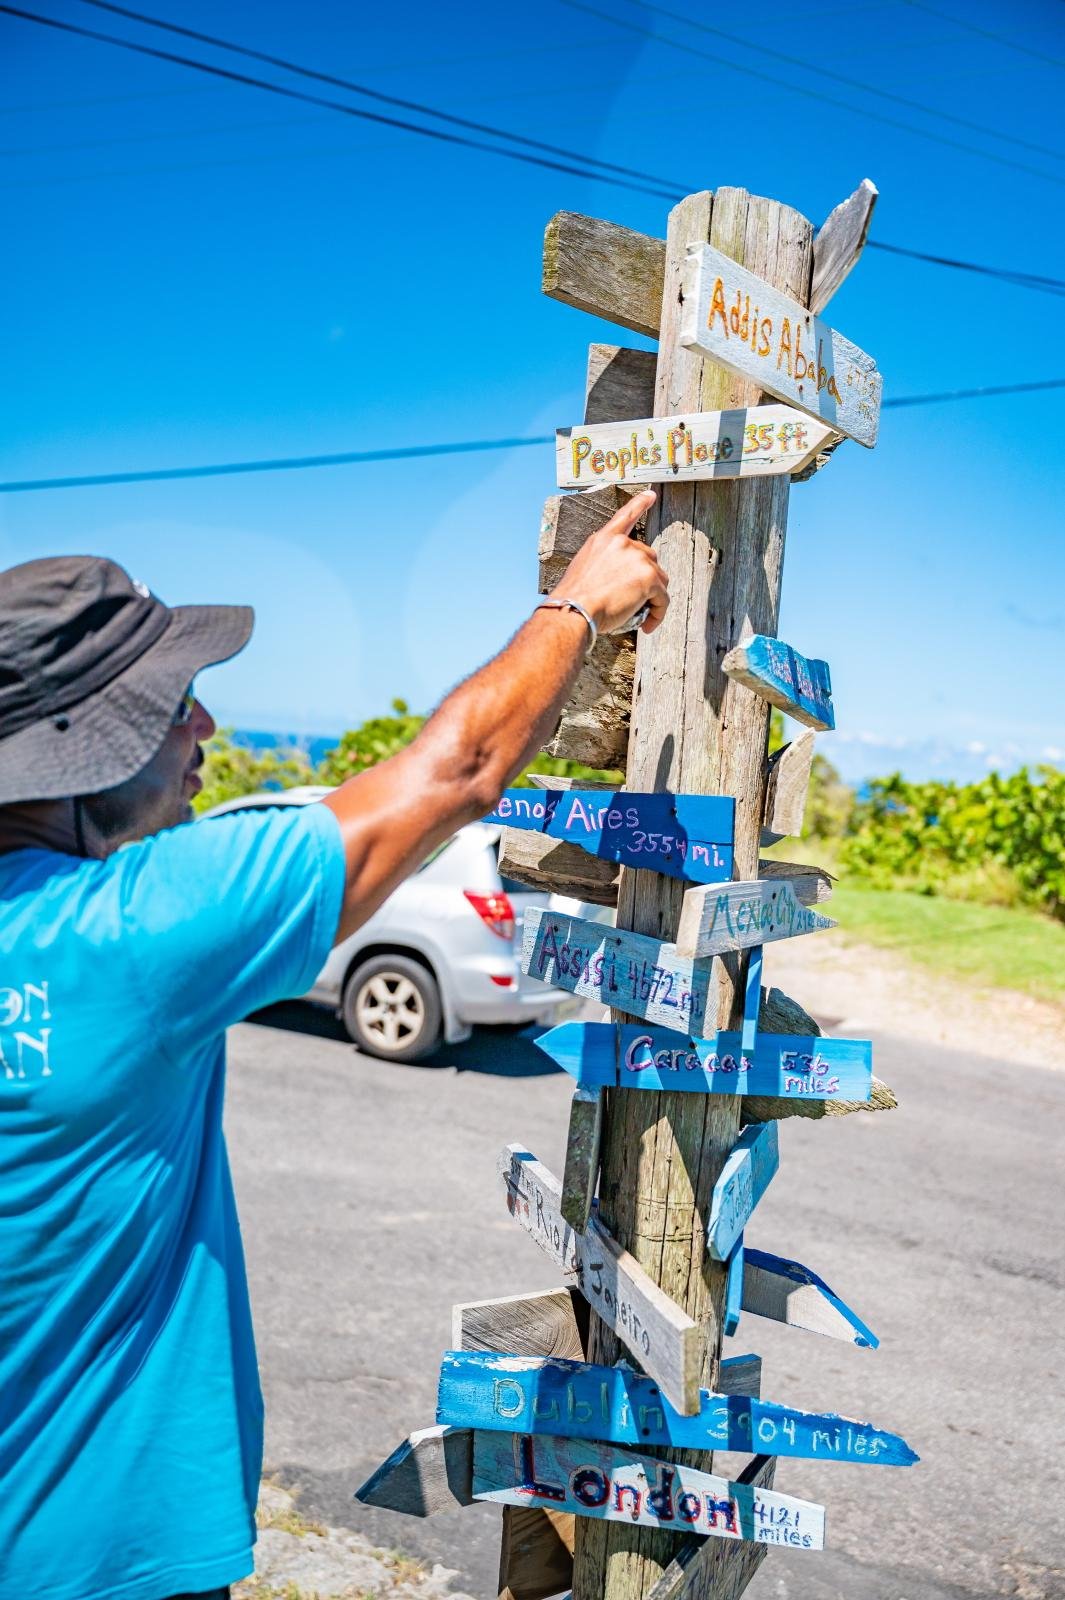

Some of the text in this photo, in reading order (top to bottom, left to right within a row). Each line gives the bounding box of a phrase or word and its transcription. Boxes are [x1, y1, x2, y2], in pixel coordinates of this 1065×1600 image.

[707, 275, 773, 358] Addis
[776, 316, 842, 405] Ababa
[571, 421, 810, 479] People's Place 35 ft
[565, 797, 640, 833] Aires
[626, 830, 688, 860] 3554
[536, 926, 618, 993] Assisi
[628, 960, 679, 1008] 4672
[624, 1035, 829, 1077] Caracas 536
[535, 1186, 560, 1251] Rio
[493, 1377, 663, 1430] Dublin
[706, 1407, 796, 1446] 3904
[512, 1435, 800, 1535] London 4121
[757, 1528, 813, 1548] miles
